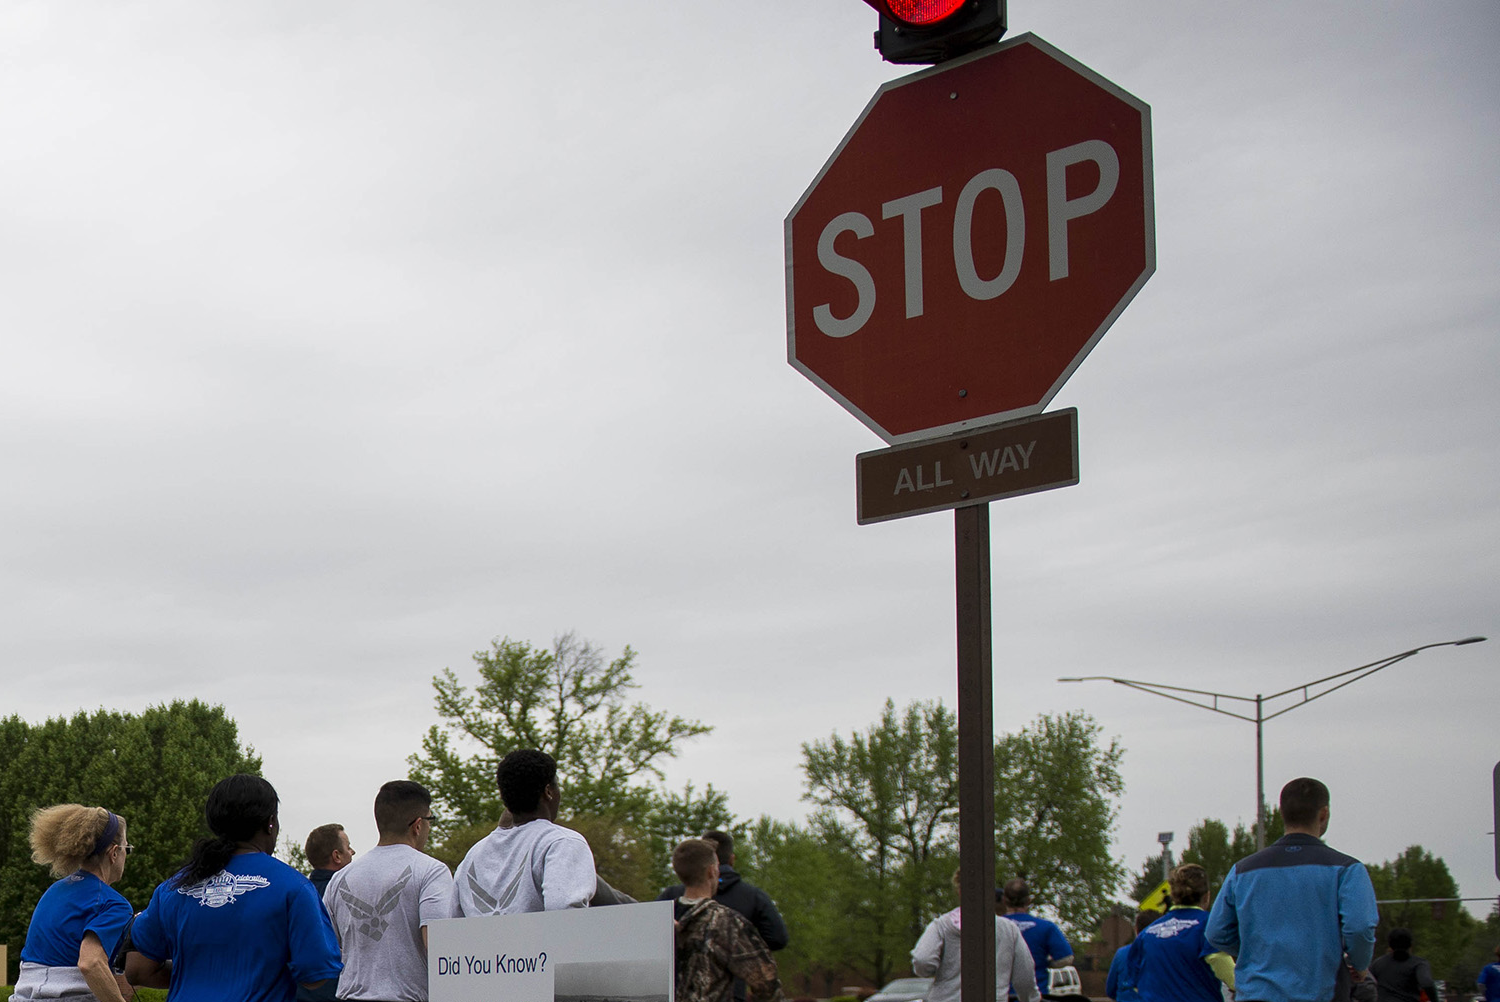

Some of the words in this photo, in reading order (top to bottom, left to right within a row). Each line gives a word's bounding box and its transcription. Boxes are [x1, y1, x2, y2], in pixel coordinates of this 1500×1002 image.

[813, 139, 1120, 338] STOP
[894, 461, 953, 495] ALL
[969, 441, 1037, 480] WAY
[438, 956, 460, 975] Did
[464, 955, 491, 974] You
[496, 952, 547, 974] Know?
